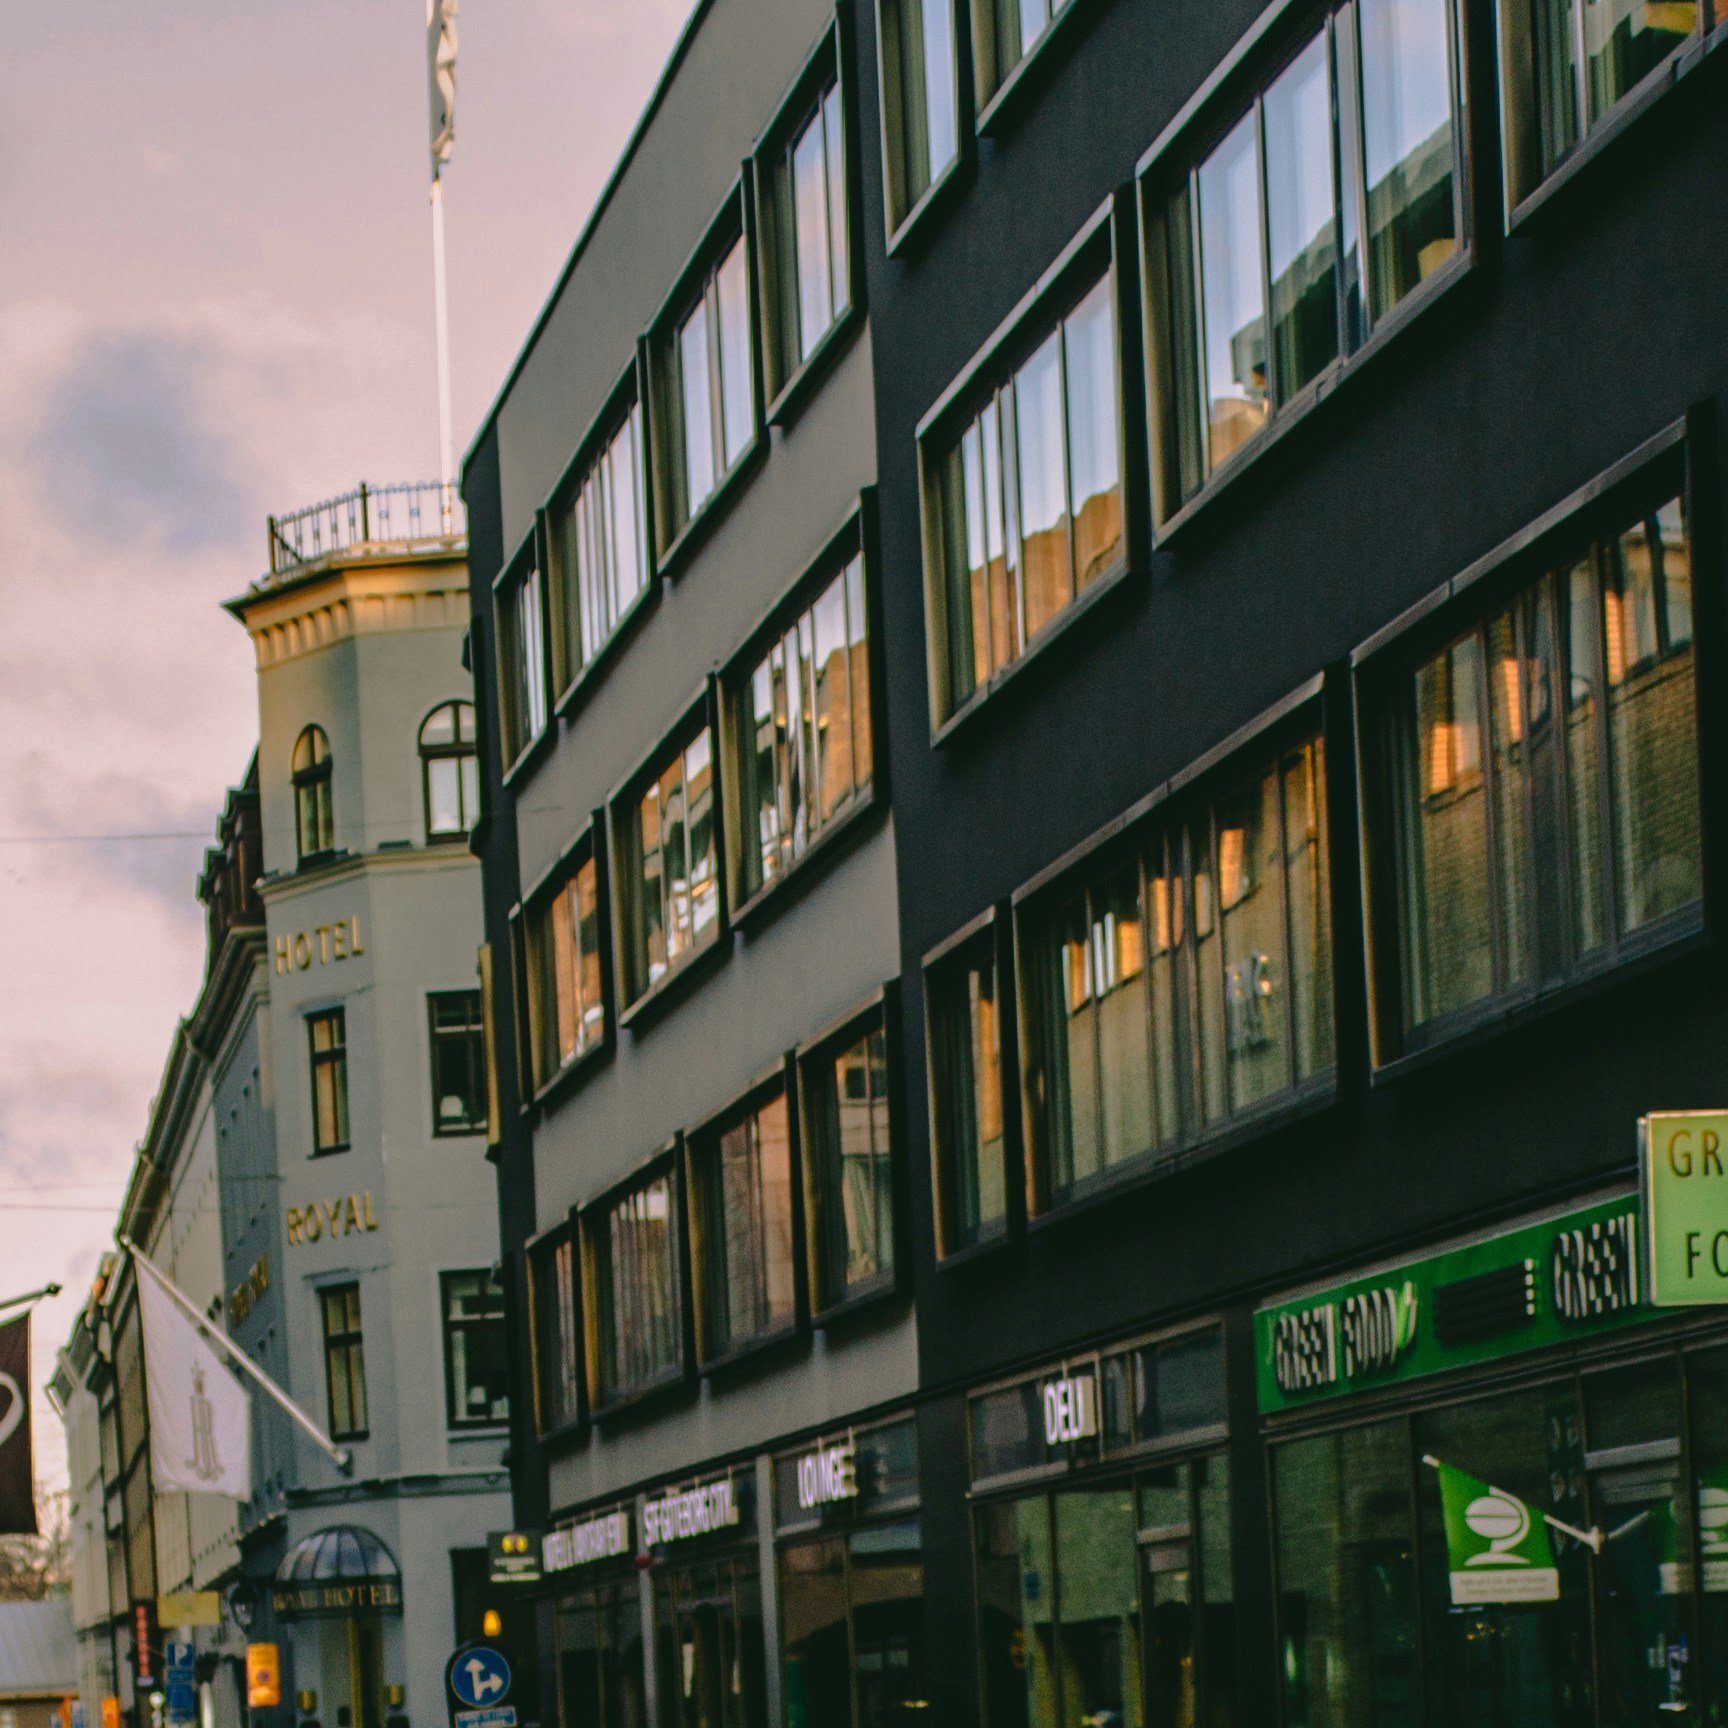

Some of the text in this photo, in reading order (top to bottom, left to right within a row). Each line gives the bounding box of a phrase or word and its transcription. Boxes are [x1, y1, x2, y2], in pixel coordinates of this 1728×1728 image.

[275, 915, 365, 976] HOTEL
[287, 1193, 379, 1245] ROYAL
[798, 1444, 858, 1509] LOUNGE
[323, 1583, 399, 1608] HOTEL
